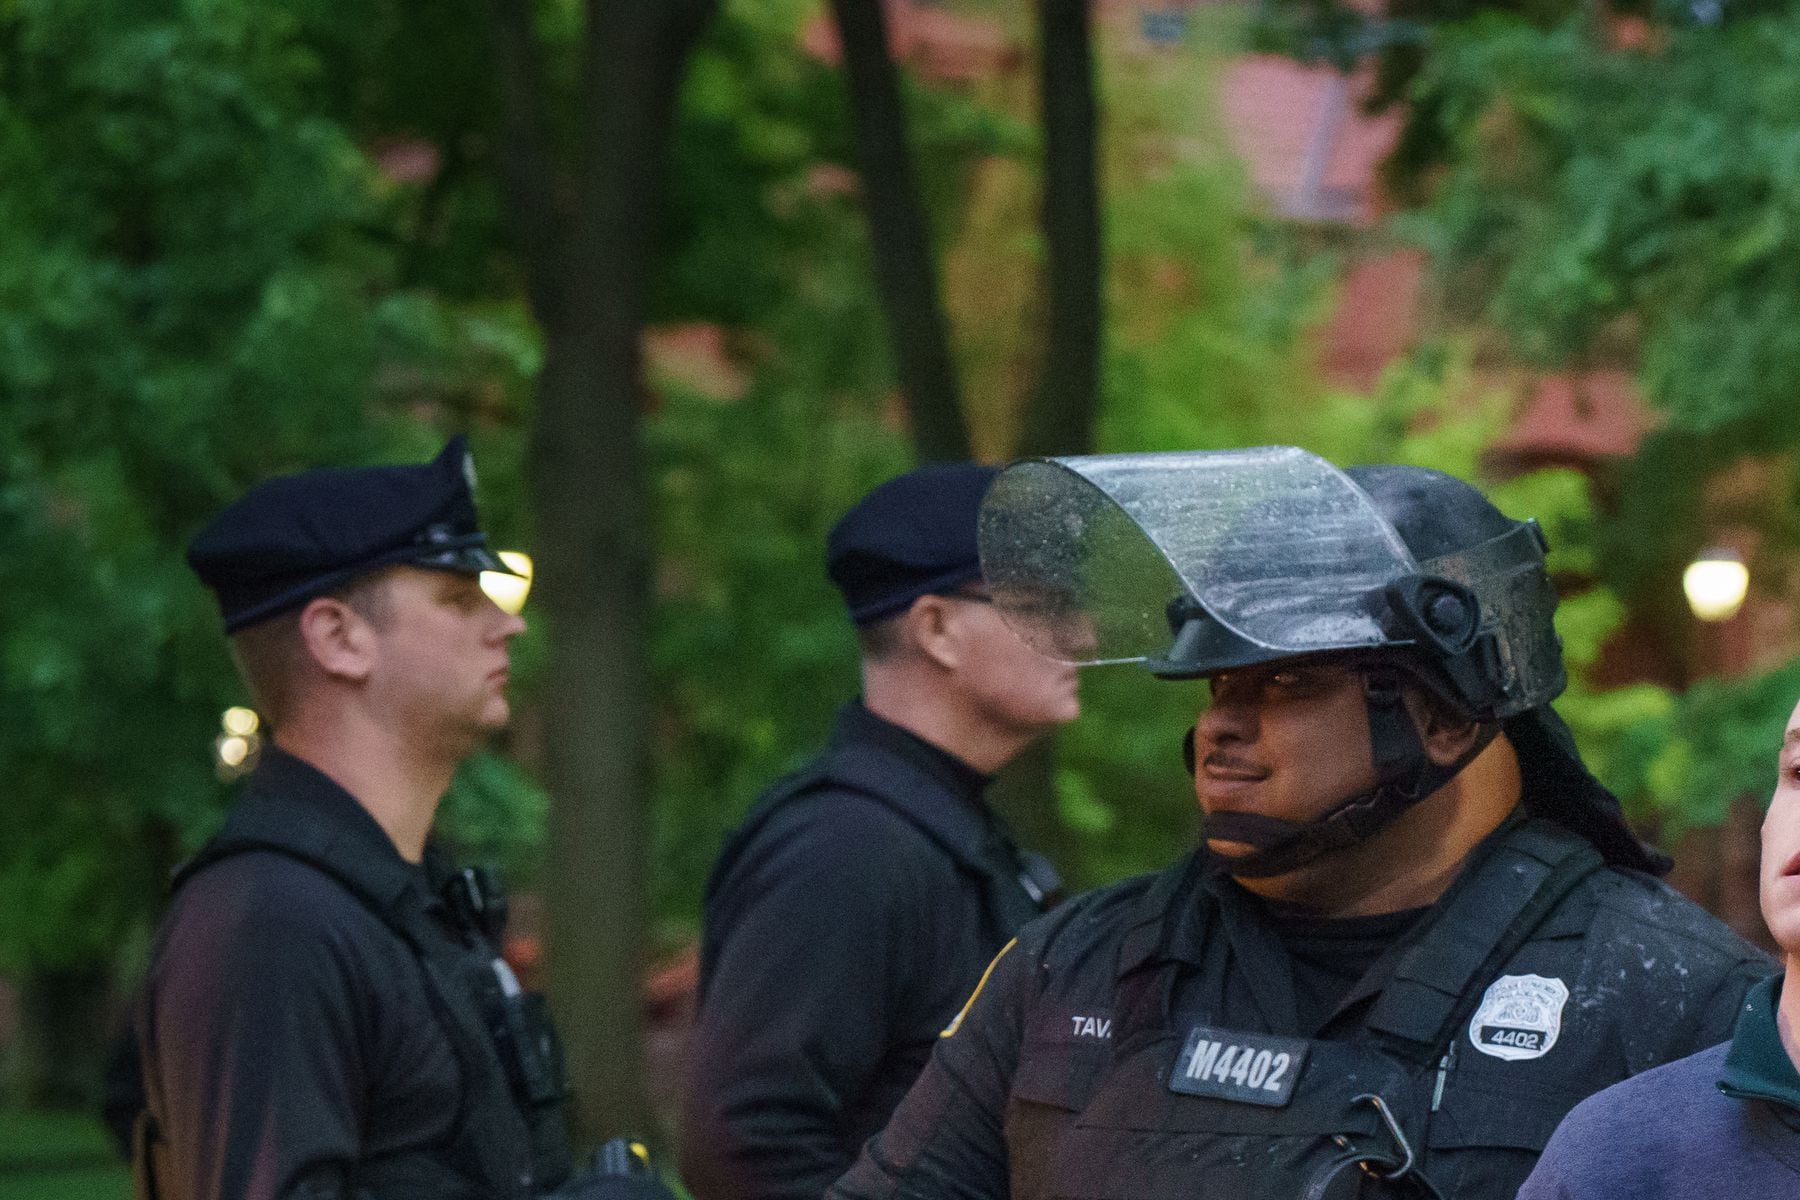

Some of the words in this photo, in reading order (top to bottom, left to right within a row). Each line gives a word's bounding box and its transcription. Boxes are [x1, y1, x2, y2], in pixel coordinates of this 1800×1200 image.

[1072, 1015, 1112, 1039] TAV
[1491, 1030, 1540, 1050] 4402
[1185, 1039, 1291, 1092] M4402
